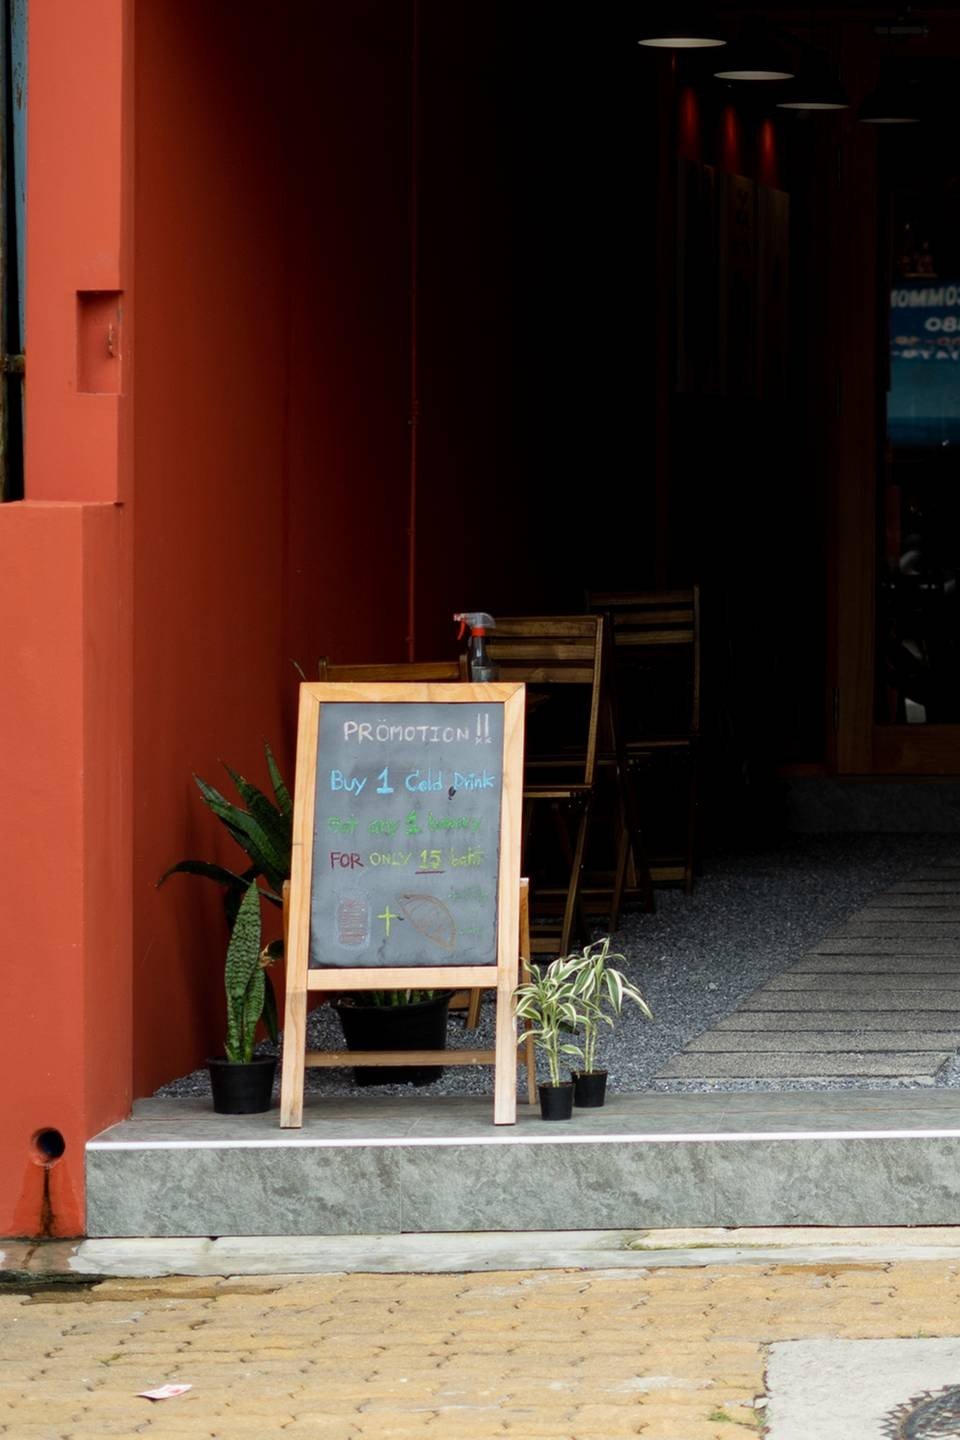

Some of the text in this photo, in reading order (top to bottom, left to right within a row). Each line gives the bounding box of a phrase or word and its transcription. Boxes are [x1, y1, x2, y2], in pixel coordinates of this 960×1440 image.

[330, 766, 497, 796] Buy 1 Cold Drink
[329, 851, 365, 870] FOR
[368, 851, 414, 867] ONLY
[418, 848, 443, 871] 15
